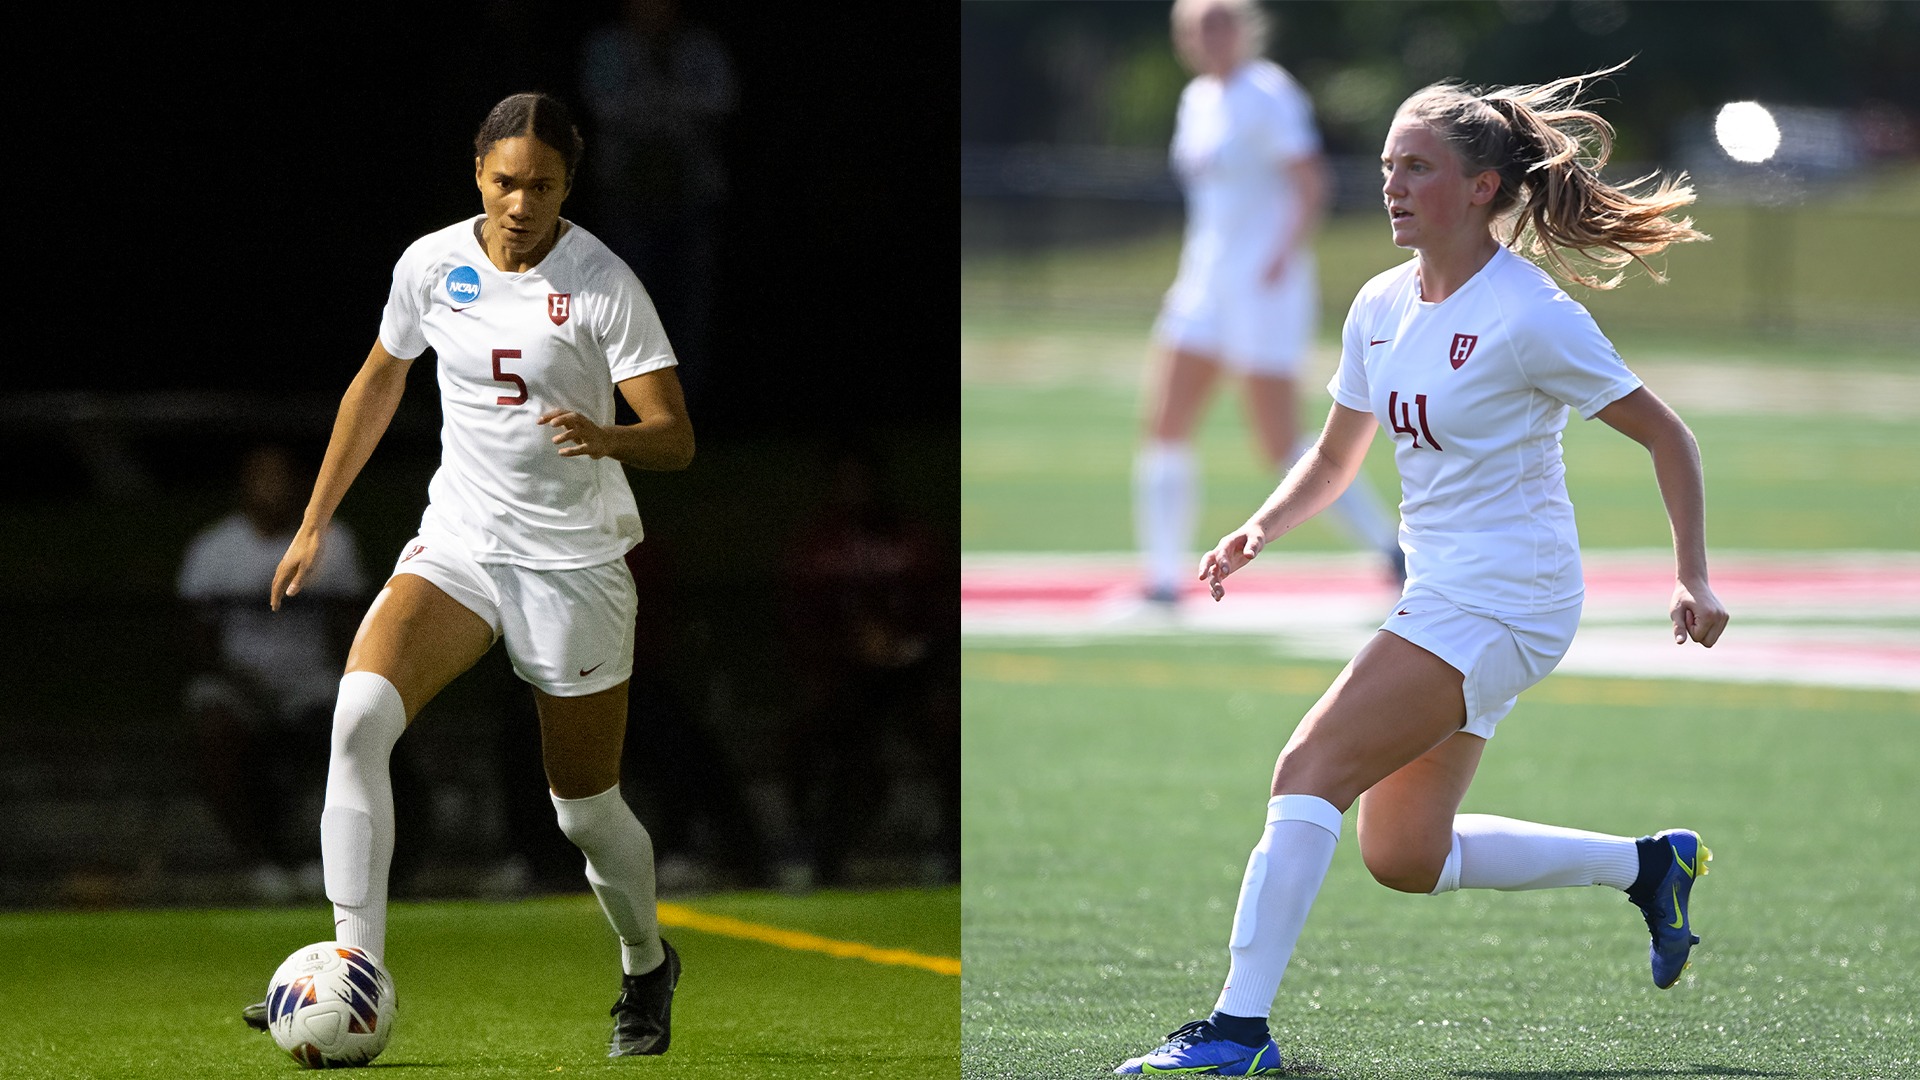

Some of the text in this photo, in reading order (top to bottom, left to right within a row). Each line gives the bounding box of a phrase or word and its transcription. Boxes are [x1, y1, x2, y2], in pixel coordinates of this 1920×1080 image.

[449, 281, 479, 295] NCAA
[551, 296, 568, 317] H
[1452, 337, 1473, 360] H
[491, 349, 529, 405] 5
[1388, 391, 1443, 451] 41
